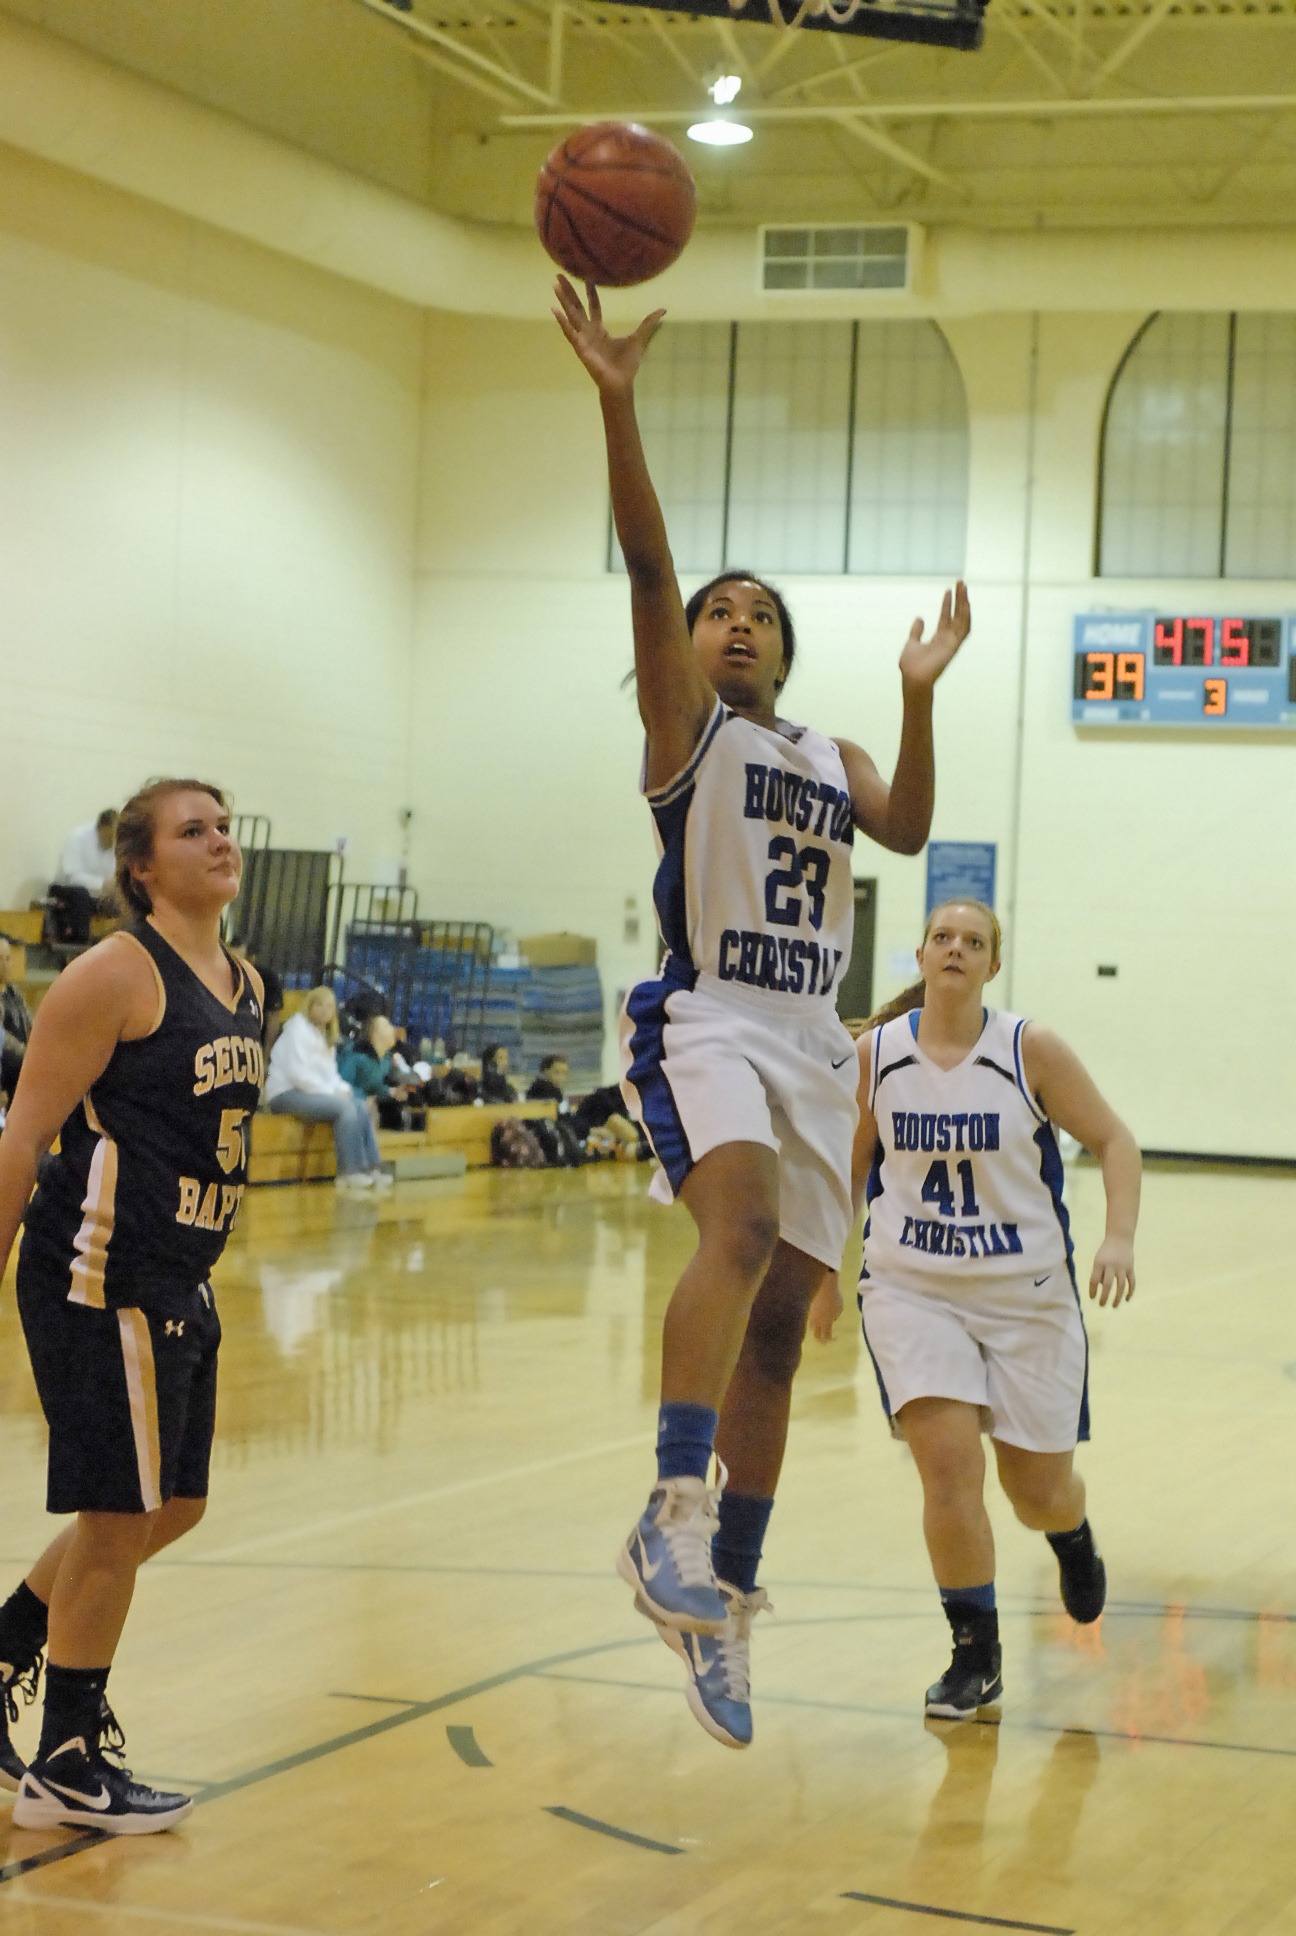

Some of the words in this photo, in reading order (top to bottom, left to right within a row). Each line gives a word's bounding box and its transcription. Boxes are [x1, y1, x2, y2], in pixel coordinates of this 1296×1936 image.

[1085, 652, 1145, 700] 39
[1203, 679, 1227, 715] 3
[765, 835, 831, 931] 23
[216, 1108, 250, 1175] 5
[892, 1111, 1000, 1152] HOUSTON
[921, 1159, 980, 1217] 41
[899, 1216, 1024, 1258] CHRISTIAN
